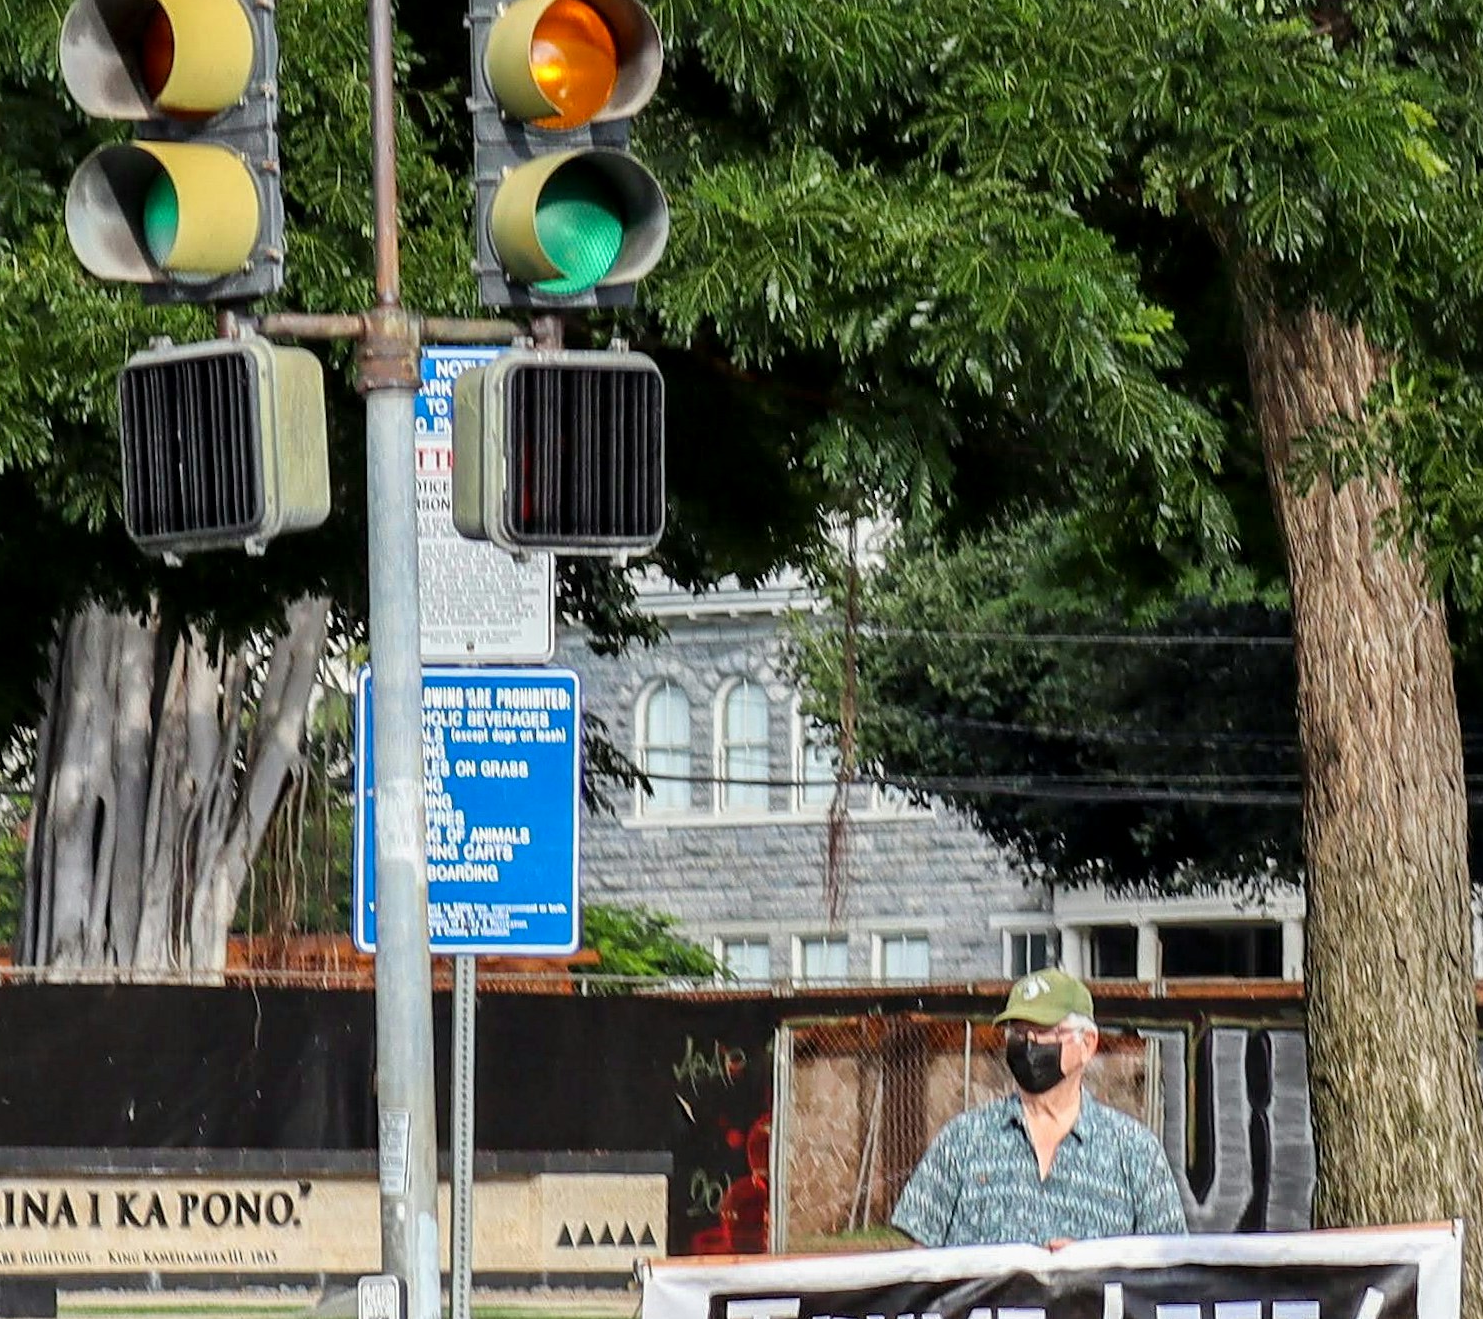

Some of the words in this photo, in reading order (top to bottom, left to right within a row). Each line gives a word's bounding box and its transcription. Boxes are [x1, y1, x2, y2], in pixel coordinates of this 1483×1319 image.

[467, 711, 549, 728] BEVERAGES
[520, 730, 534, 742] on
[455, 760, 476, 777] ON
[481, 760, 529, 778] GRASS
[446, 827, 465, 843] OF
[470, 827, 530, 845] ANIMALS
[463, 844, 513, 861] CARTS
[88, 1191, 102, 1227] I
[116, 1190, 169, 1229] KA
